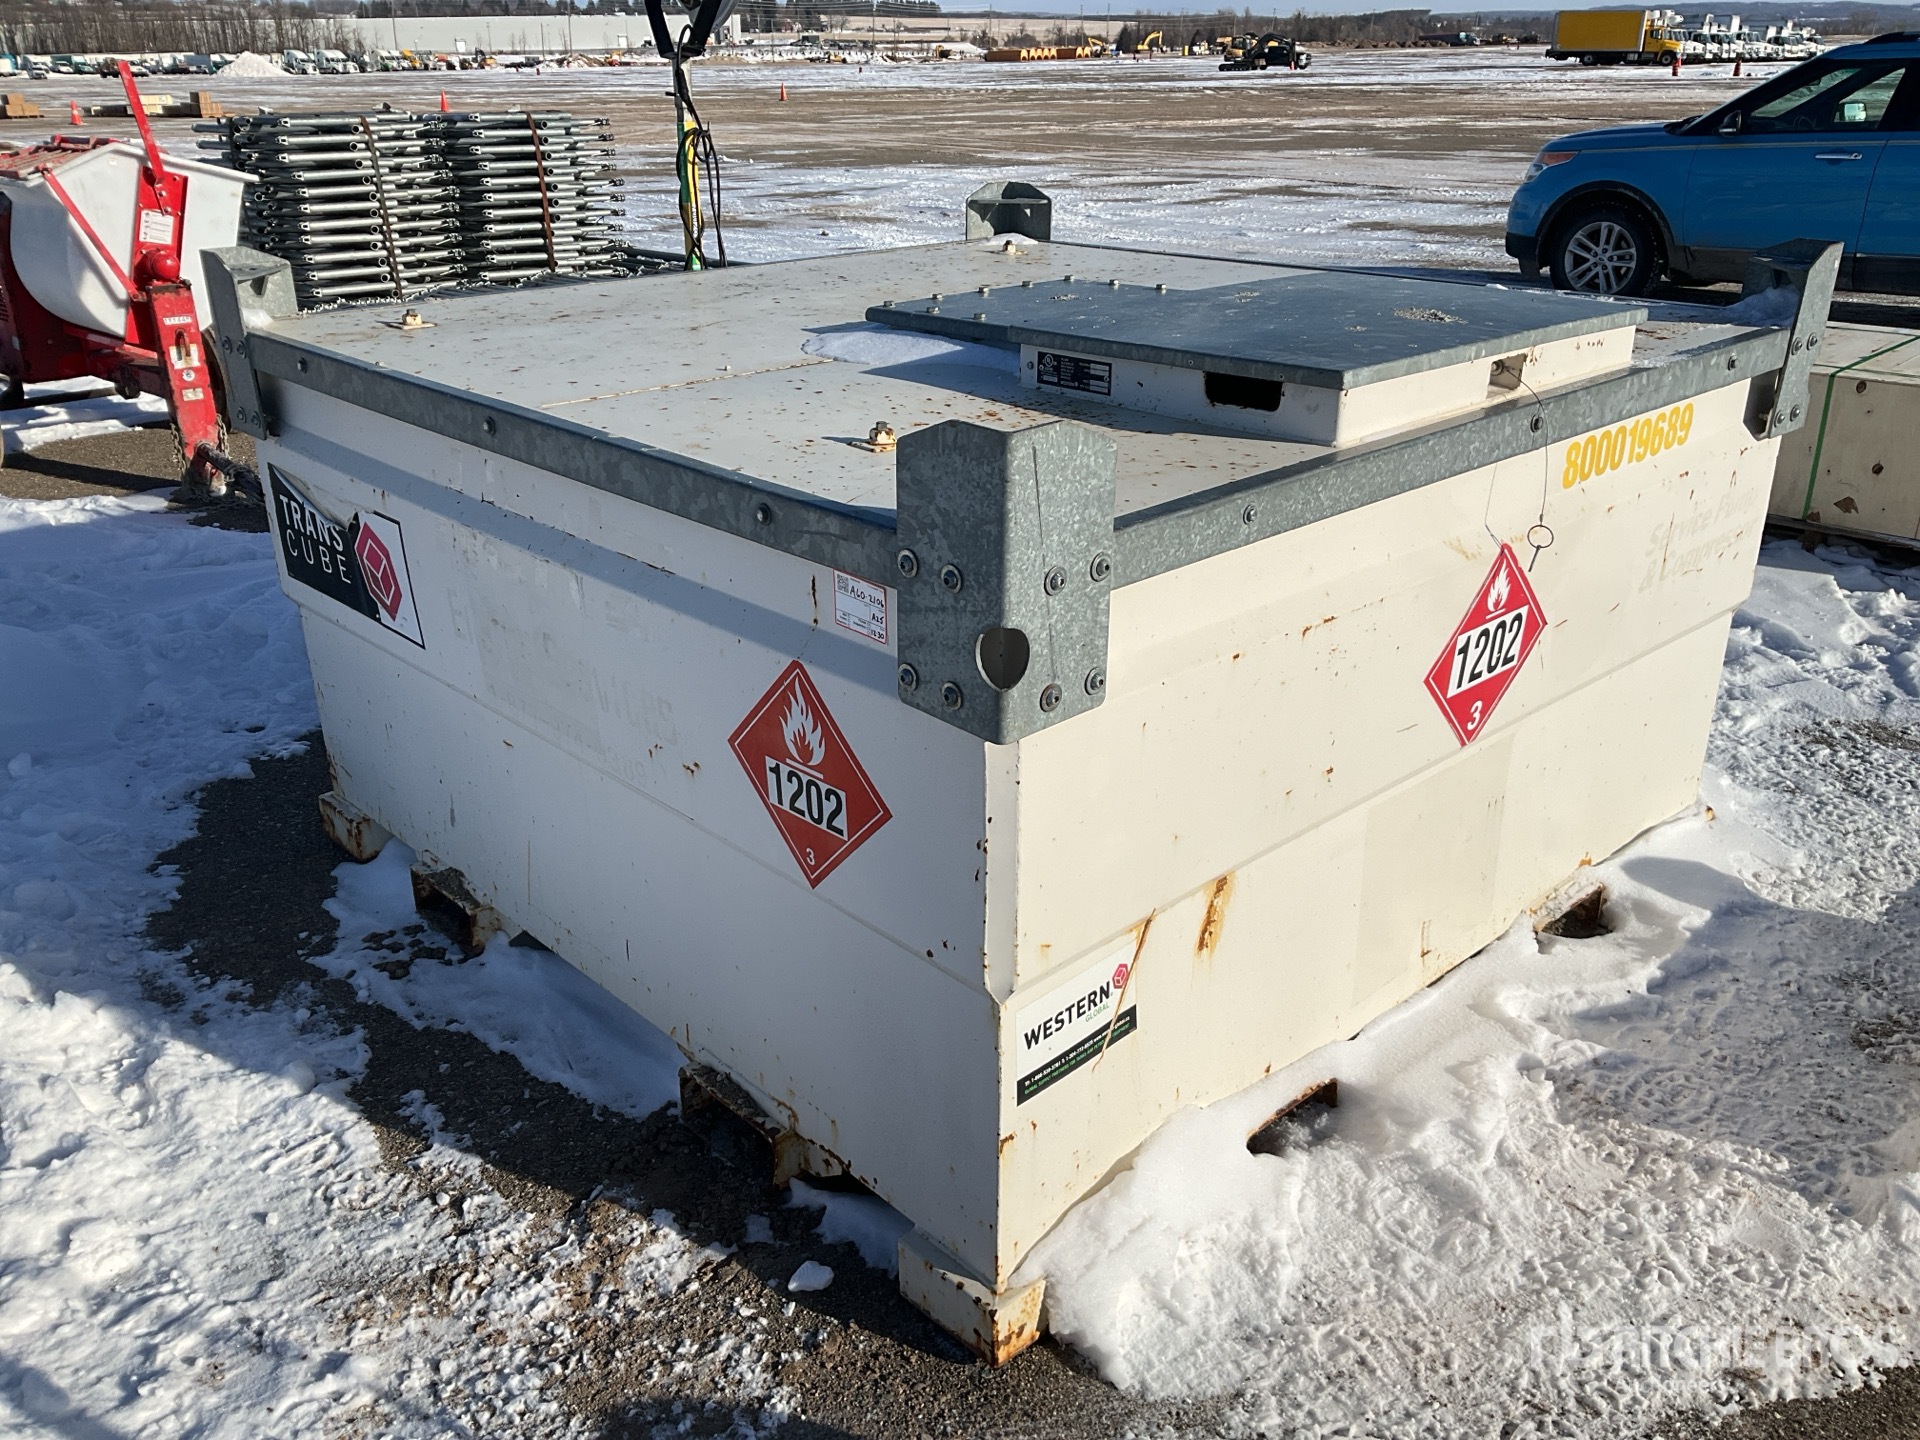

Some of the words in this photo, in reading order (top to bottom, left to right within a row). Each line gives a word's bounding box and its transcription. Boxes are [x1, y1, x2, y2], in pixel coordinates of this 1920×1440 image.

[1562, 402, 1694, 489] 800019689
[280, 494, 344, 552] TRANS
[286, 529, 351, 584] CUBE
[1456, 612, 1523, 690] 1202
[1467, 701, 1483, 730] 3
[769, 762, 845, 837] 1202
[806, 848, 816, 866] 3
[1023, 981, 1111, 1050] WESTERN
[1085, 1002, 1110, 1023] GLOBAL
